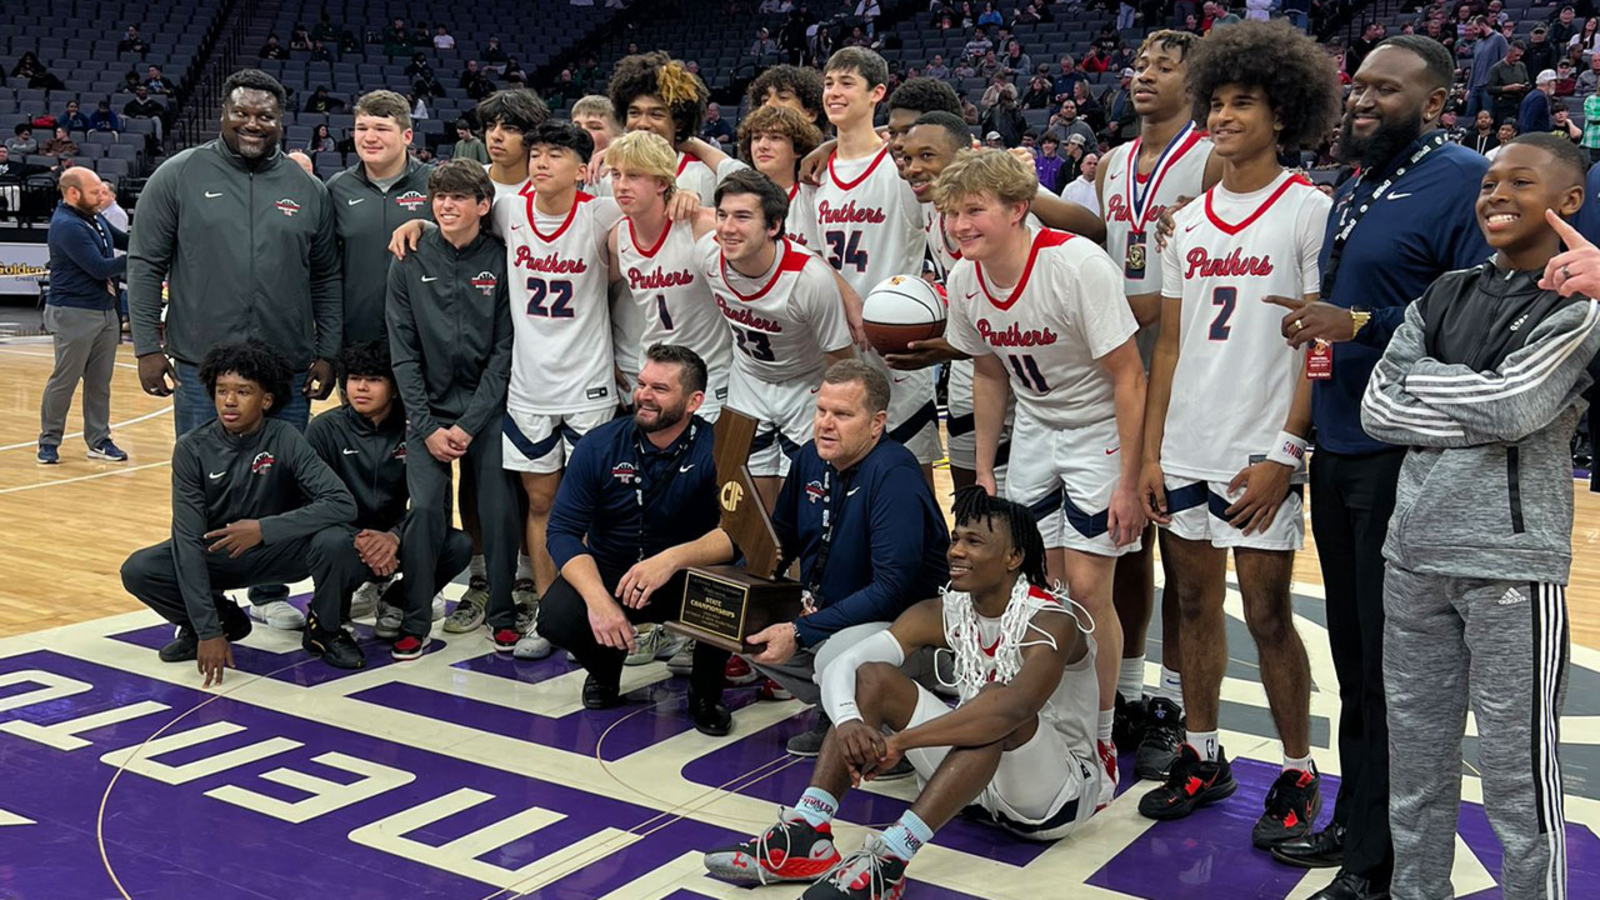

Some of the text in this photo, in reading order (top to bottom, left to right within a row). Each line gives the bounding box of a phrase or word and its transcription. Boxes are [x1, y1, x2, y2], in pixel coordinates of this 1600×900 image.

[818, 199, 886, 225] Panthers
[1106, 193, 1170, 222] Paner
[514, 245, 587, 274] Panthers
[825, 230, 868, 273] 34
[1184, 246, 1274, 280] Panthers
[627, 265, 694, 290] Panthers
[526, 277, 575, 318] 22
[656, 294, 674, 331] 1
[714, 292, 782, 333] Panthers
[1208, 286, 1238, 341] 2
[976, 318, 1058, 347] Panthers
[1008, 354, 1051, 393] 11
